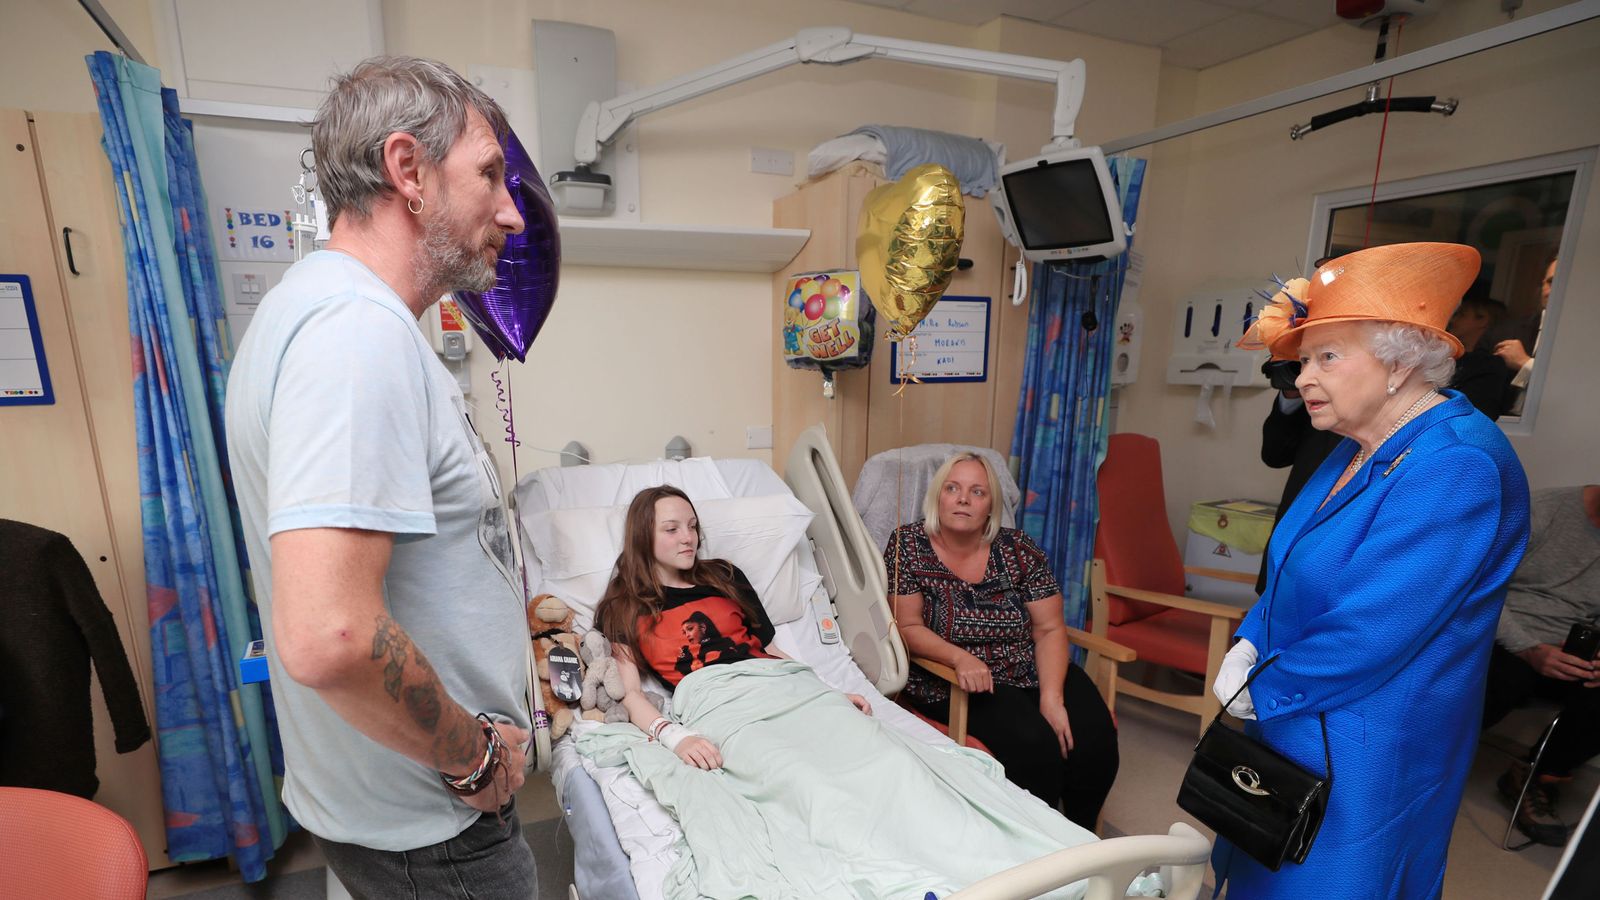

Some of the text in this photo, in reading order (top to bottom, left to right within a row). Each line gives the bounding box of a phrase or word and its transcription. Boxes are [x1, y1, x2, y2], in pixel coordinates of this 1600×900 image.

[238, 212, 281, 227] BED
[251, 235, 275, 249] 16
[808, 318, 841, 343] GET
[808, 330, 855, 358] WELL
